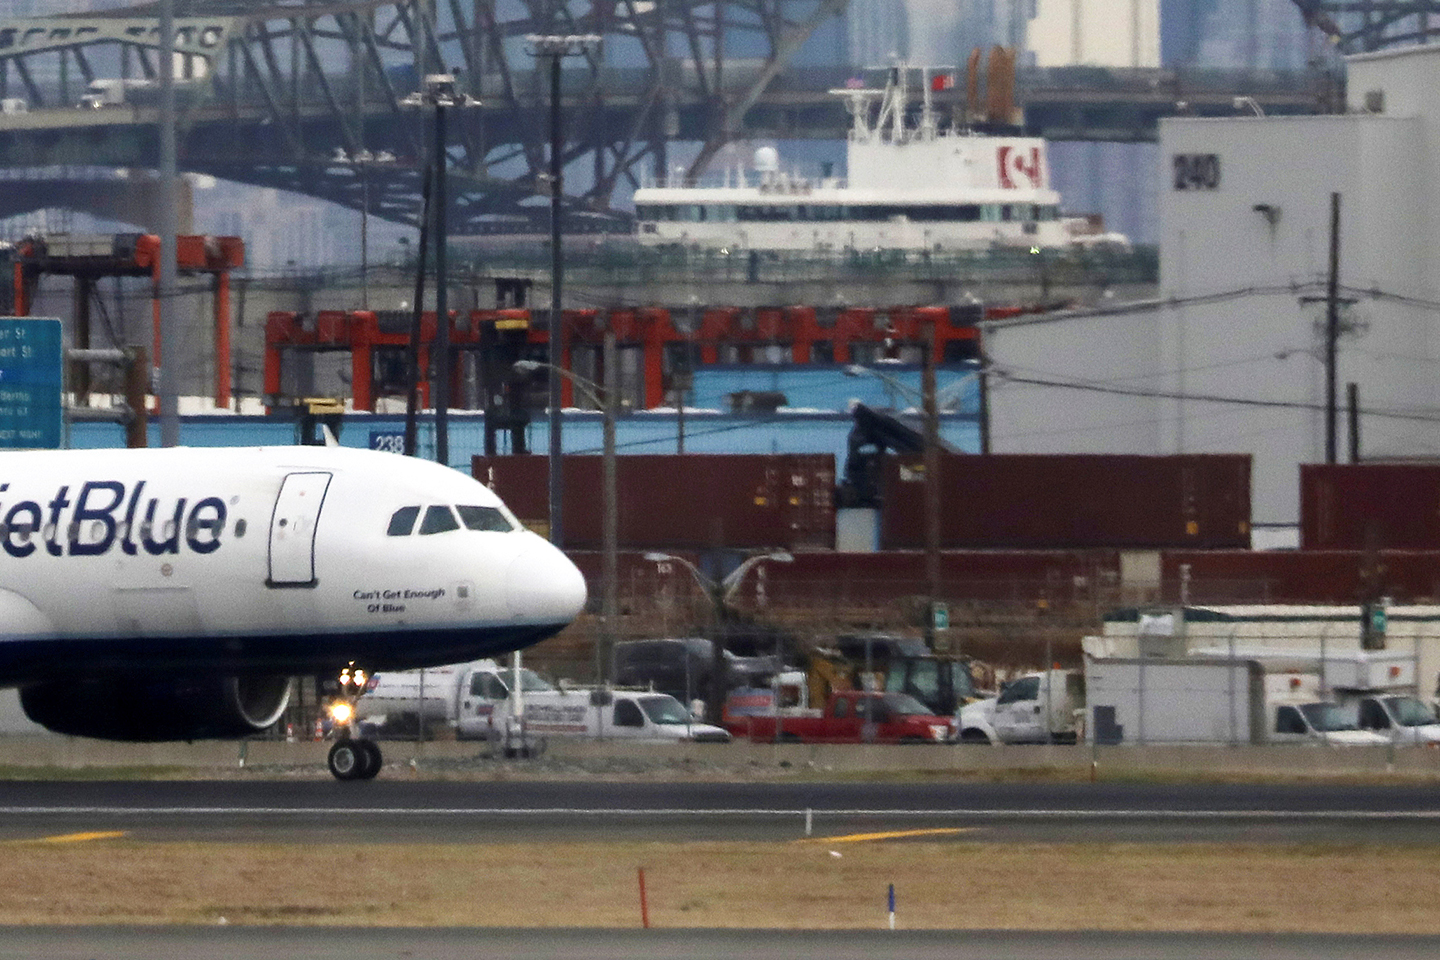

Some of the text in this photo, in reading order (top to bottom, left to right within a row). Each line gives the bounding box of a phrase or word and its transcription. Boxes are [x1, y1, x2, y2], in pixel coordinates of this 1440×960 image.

[1173, 153, 1220, 191] 240
[15, 327, 26, 339] St
[21, 345, 33, 358] St
[376, 435, 405, 453] 238
[353, 588, 446, 600] Can't Get Enough
[367, 604, 406, 613] Of Blue
